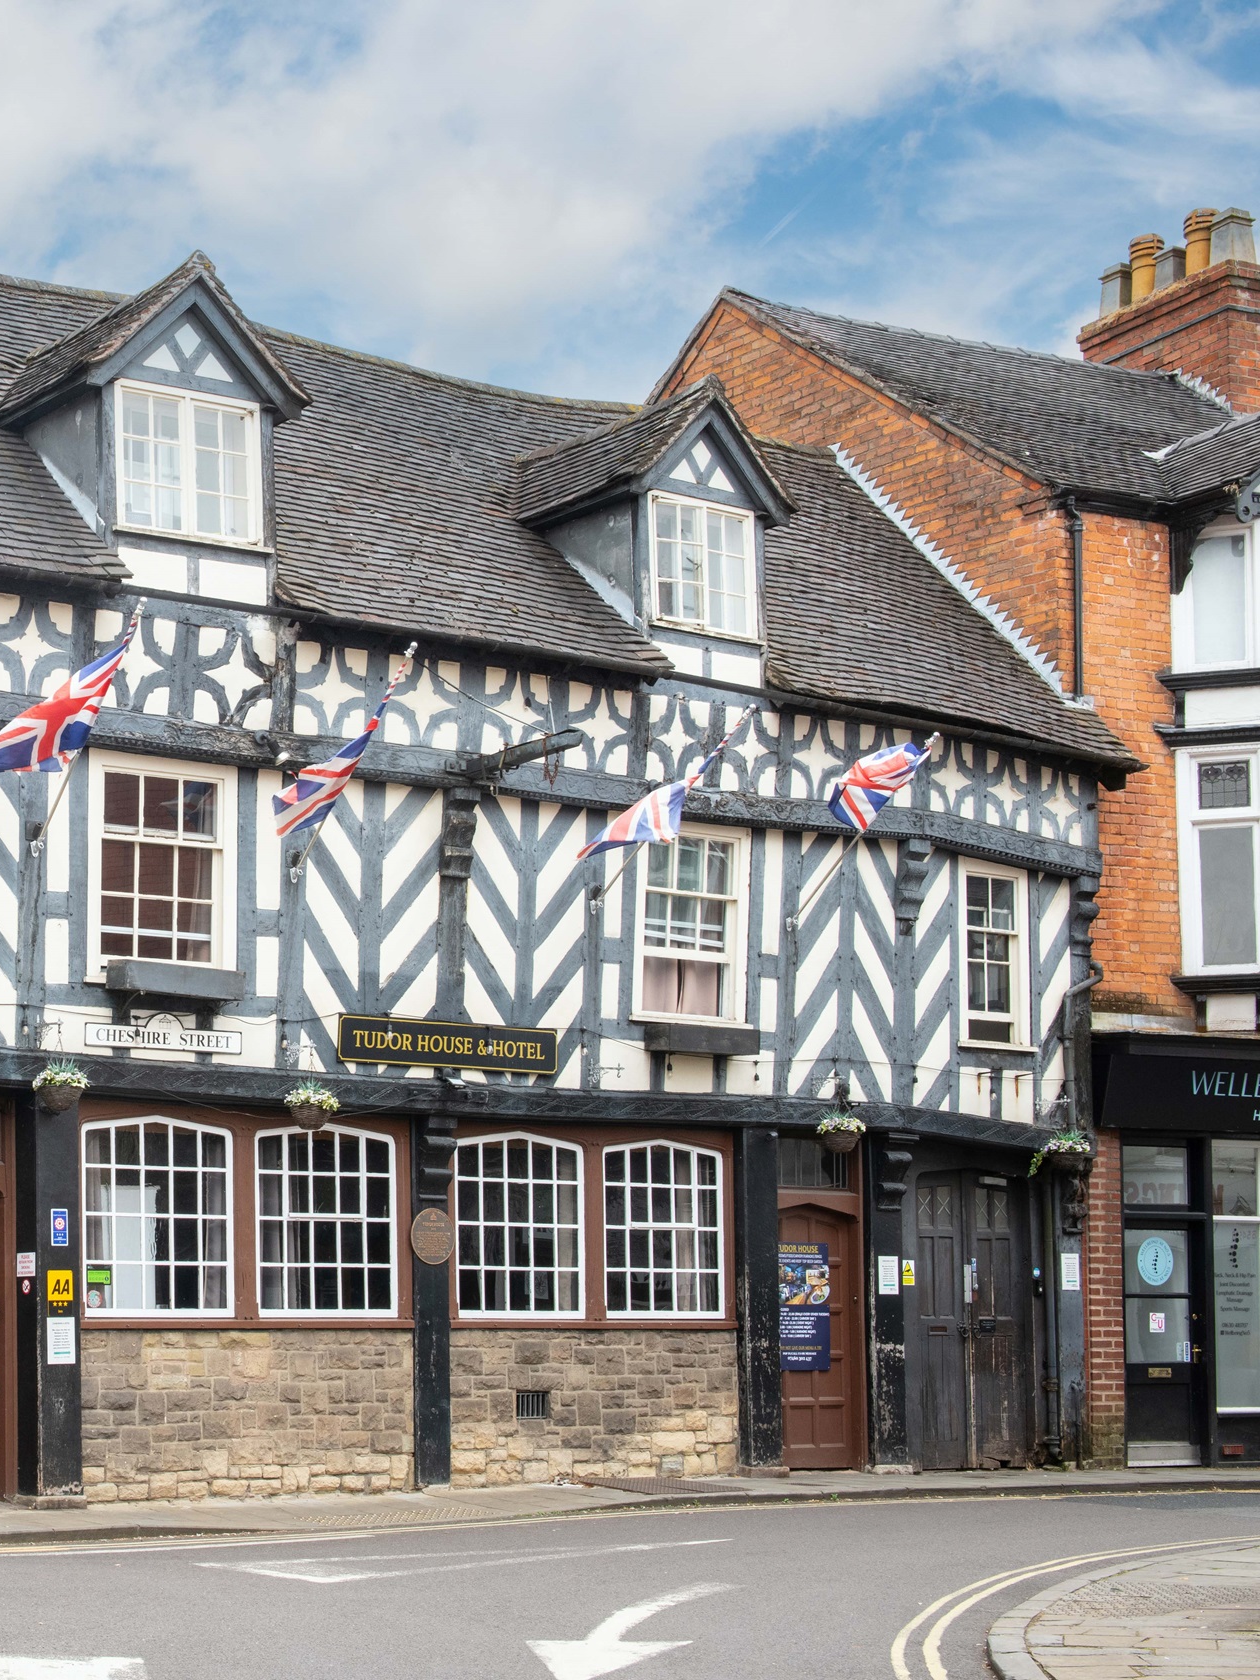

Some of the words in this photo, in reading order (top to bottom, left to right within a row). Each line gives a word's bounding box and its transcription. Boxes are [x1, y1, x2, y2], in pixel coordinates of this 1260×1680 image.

[96, 1028, 171, 1046] CHESHIRE
[179, 1033, 232, 1048] STREET
[352, 1030, 412, 1051] TUDOR
[417, 1035, 473, 1054] HOUSE
[477, 1040, 488, 1056] &
[492, 1040, 545, 1060] HOTEL
[798, 1245, 818, 1253] HOUSE
[52, 1279, 70, 1295] AA
